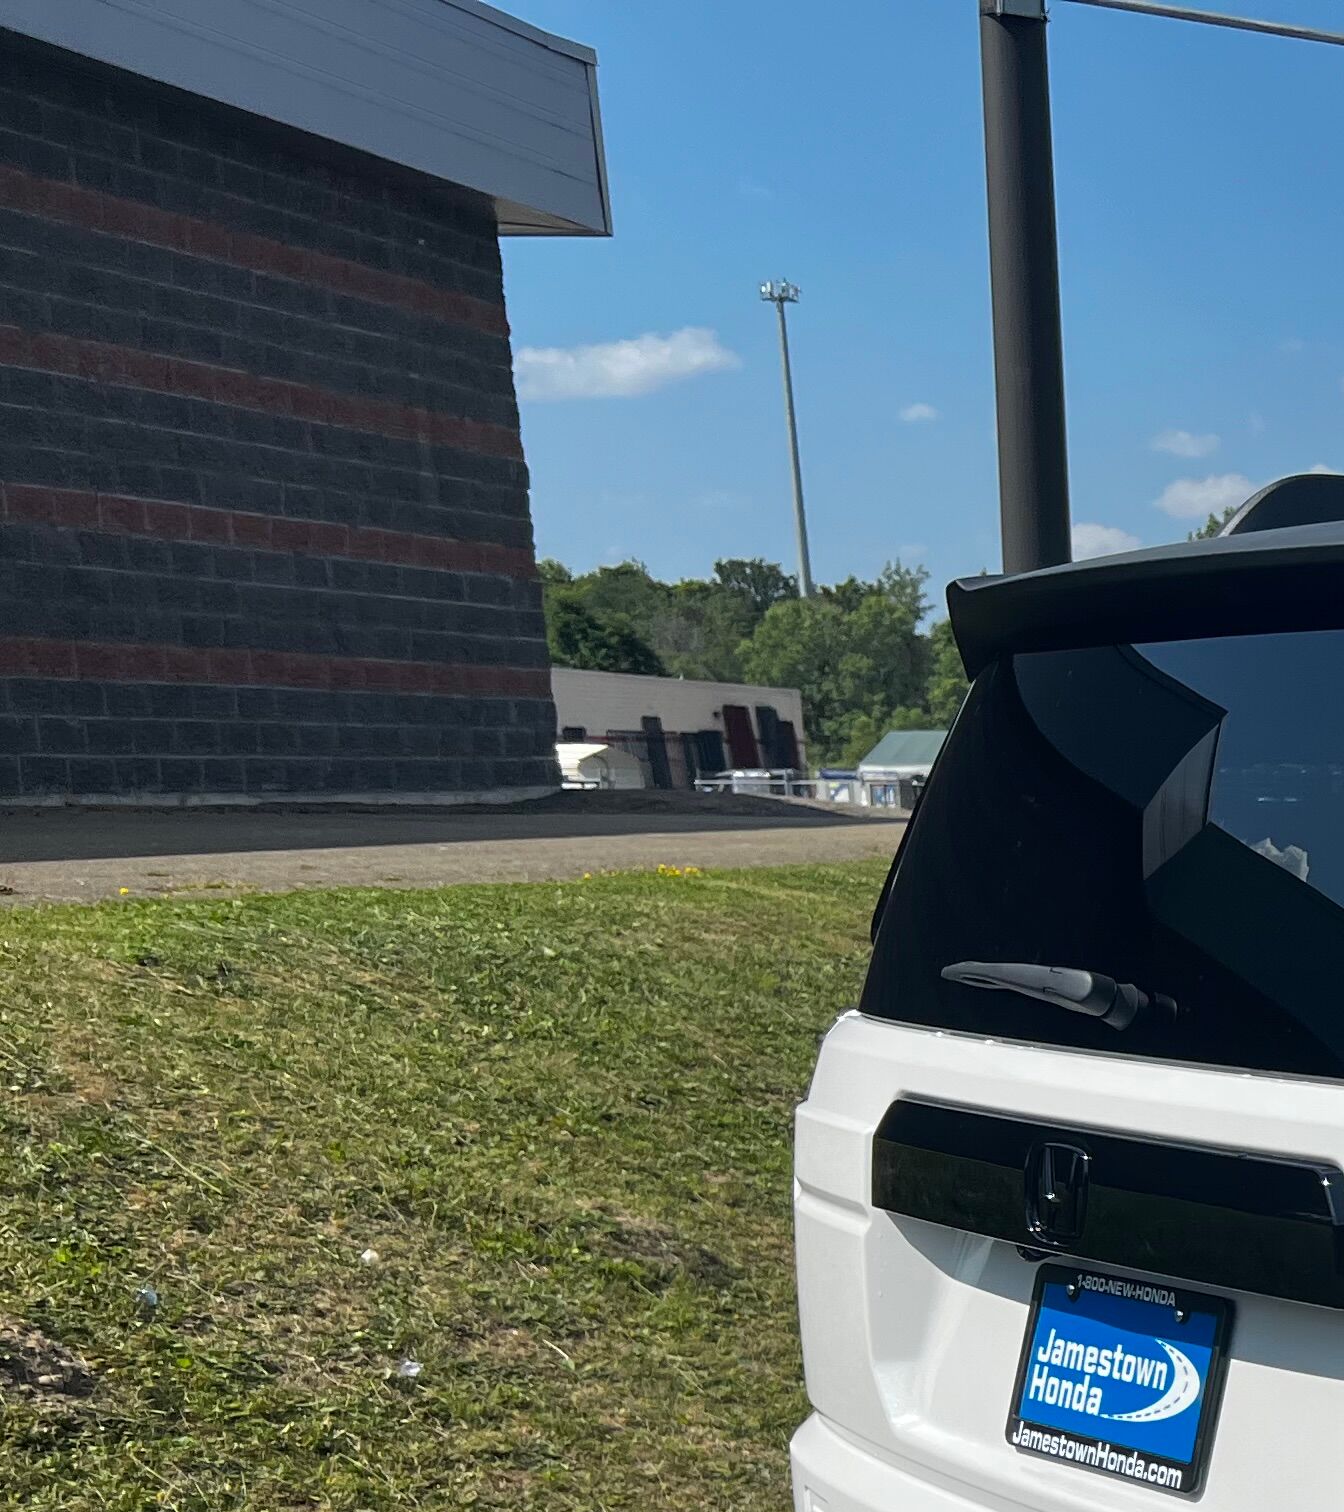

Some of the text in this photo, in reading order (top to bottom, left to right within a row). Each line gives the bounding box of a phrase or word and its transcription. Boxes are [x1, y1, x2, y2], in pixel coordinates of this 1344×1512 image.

[1077, 1273, 1176, 1307] 1-800-NEW-HONDA
[1037, 1328, 1168, 1391] Jamestown
[1029, 1364, 1103, 1416] Honda
[1012, 1420, 1182, 1489] JamestownHonda.com
